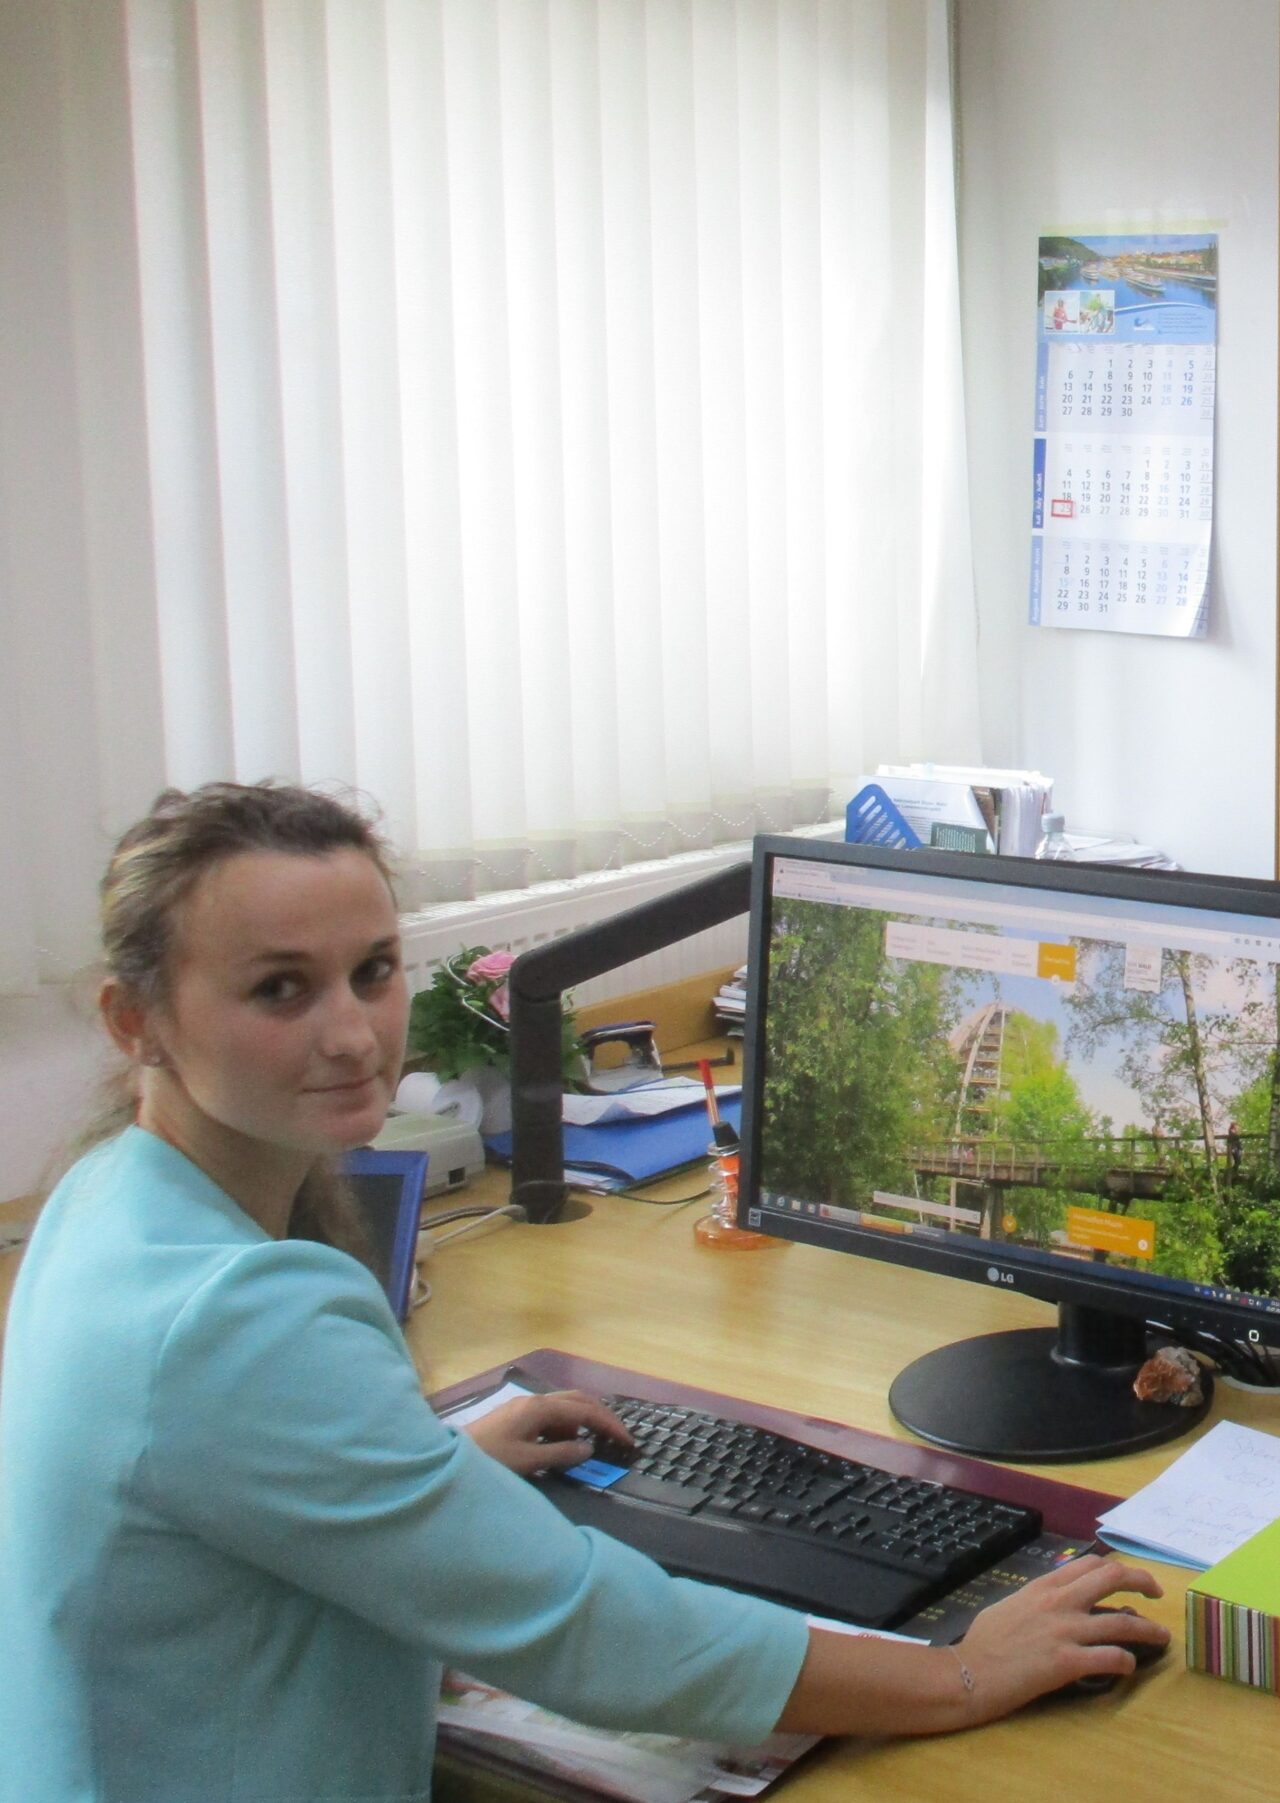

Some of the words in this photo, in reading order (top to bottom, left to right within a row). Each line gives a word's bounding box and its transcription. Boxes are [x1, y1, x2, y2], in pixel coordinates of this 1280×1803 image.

[1143, 372, 1153, 381] 10
[1183, 372, 1194, 382] 12
[1063, 382, 1073, 392] 13
[1083, 382, 1093, 392] 14
[1103, 383, 1113, 393] 15
[1122, 384, 1133, 393] 16
[1142, 384, 1153, 393] 17
[1183, 384, 1194, 394] 19
[1061, 394, 1073, 404] 20
[1081, 395, 1092, 404] 21
[1100, 395, 1113, 405] 22
[1121, 396, 1133, 405] 23
[1140, 396, 1152, 405] 24
[1180, 396, 1193, 406] 26
[1062, 406, 1073, 416] 27
[1081, 406, 1093, 417] 28
[1100, 407, 1113, 417] 29
[1121, 407, 1133, 417] 30
[1180, 472, 1191, 482] 10
[1061, 480, 1072, 489] 11
[1081, 481, 1091, 491] 12
[1101, 481, 1111, 491] 13
[1121, 482, 1131, 492] 14
[1140, 483, 1150, 493] 15
[1159, 484, 1170, 494] 16
[1179, 485, 1191, 495] 17
[1062, 492, 1072, 502] 18
[1081, 493, 1091, 502] 19
[1099, 493, 1111, 503] 20
[1119, 494, 1130, 504] 21
[1138, 495, 1150, 505] 22
[1157, 496, 1169, 506] 23
[1178, 497, 1191, 507] 24
[1080, 504, 1091, 514] 26
[1099, 505, 1111, 515] 27
[1119, 506, 1130, 516] 28
[1138, 507, 1150, 517] 29
[1178, 509, 1190, 519] 31
[1099, 568, 1110, 577] 10
[1118, 568, 1128, 578] 11
[1137, 570, 1147, 580] 12
[1157, 571, 1168, 581] 13
[1178, 572, 1189, 582] 14
[1079, 578, 1090, 588] 16
[1099, 580, 1109, 589] 17
[1118, 581, 1128, 591] 18
[1136, 582, 1147, 592] 19
[1155, 583, 1168, 593] 20
[1176, 585, 1187, 594] 21
[1057, 589, 1069, 599] 22
[1077, 590, 1089, 600] 23
[1098, 591, 1109, 601] 24
[1116, 593, 1128, 603] 25
[1135, 594, 1146, 604] 26
[1155, 595, 1167, 605] 27
[1056, 601, 1069, 611] 29
[1077, 602, 1090, 612] 30
[1098, 604, 1109, 613] 31
[1000, 1272, 1015, 1284] LG
